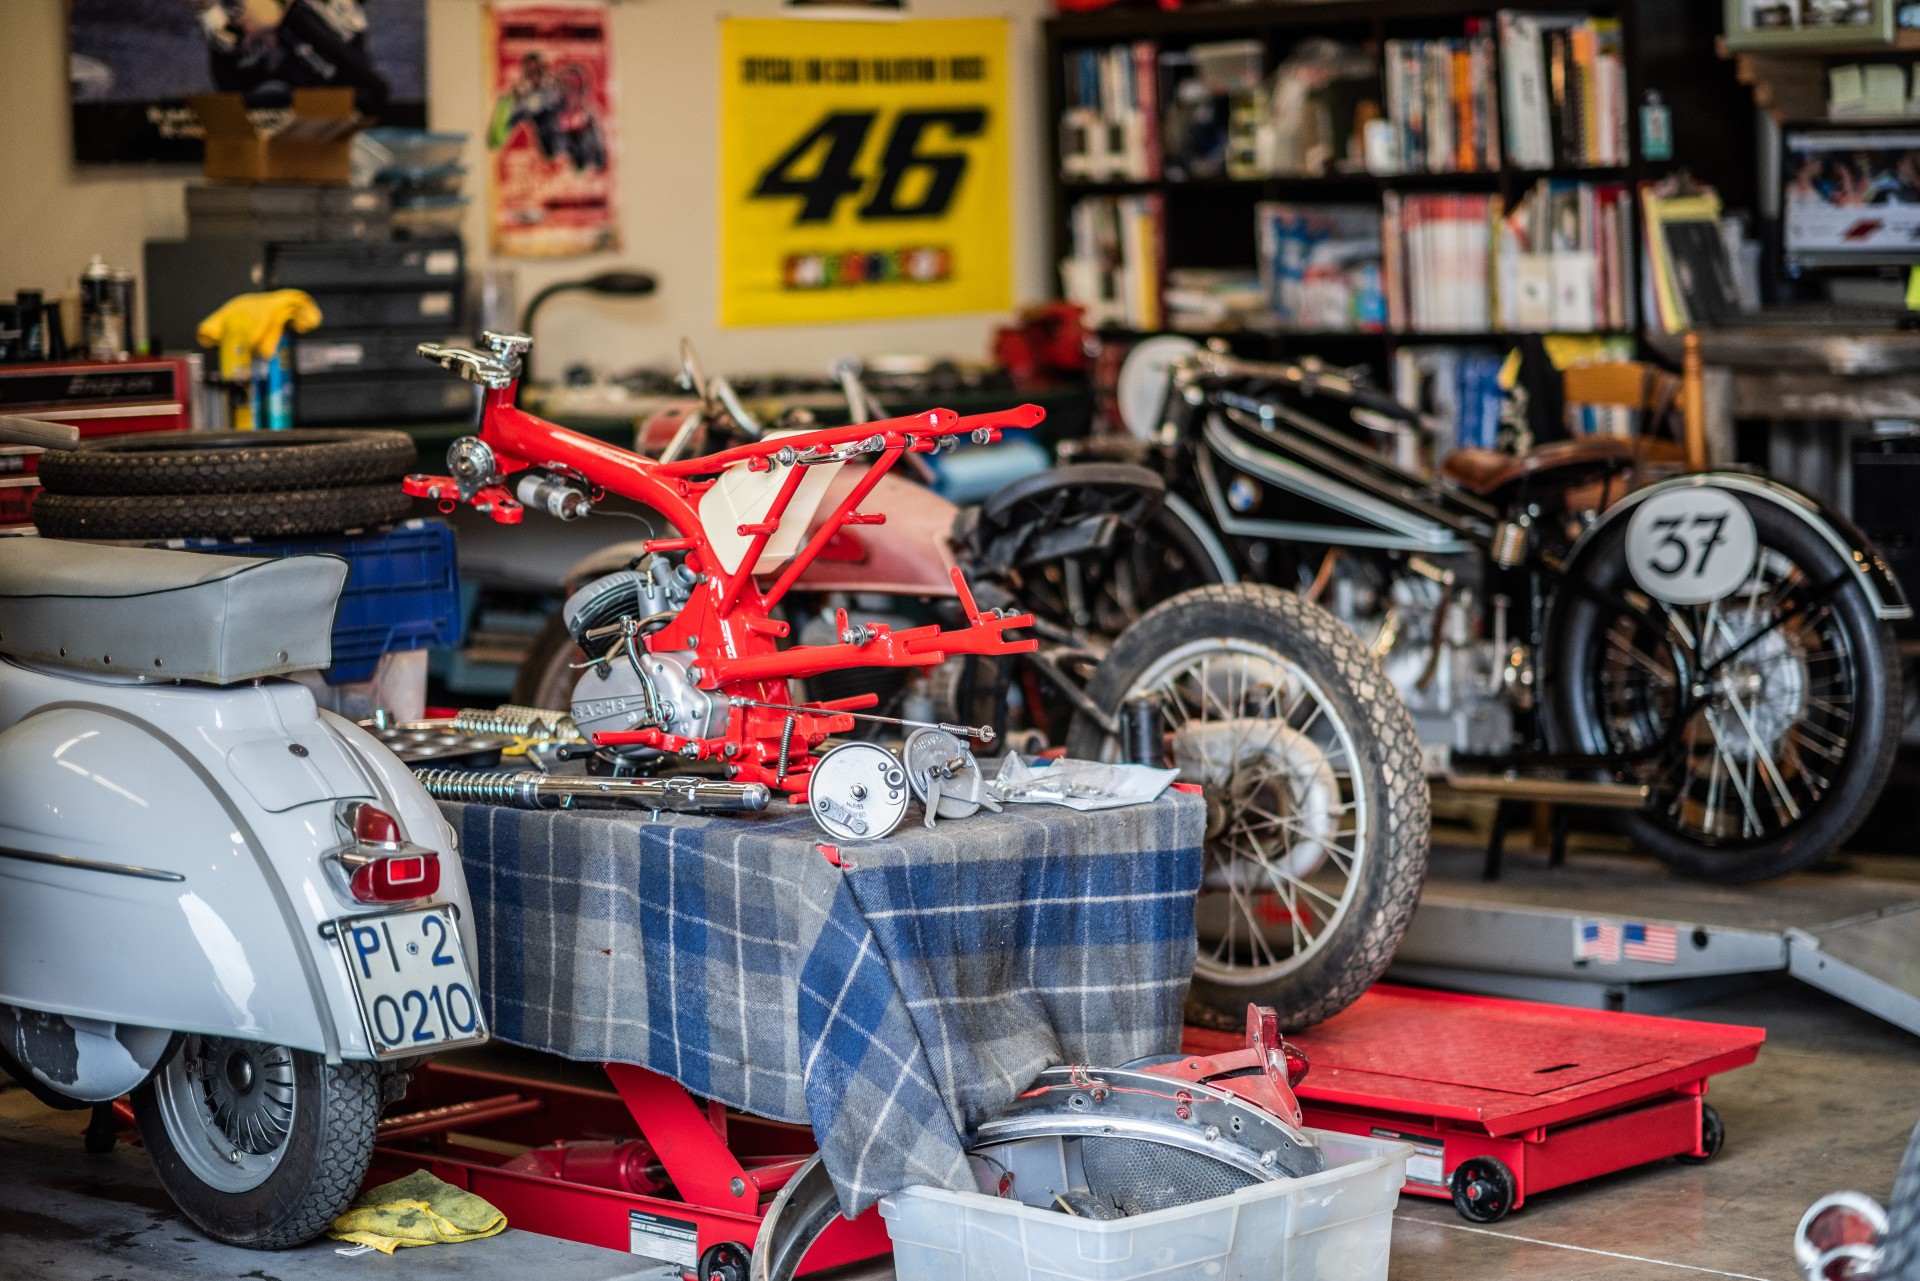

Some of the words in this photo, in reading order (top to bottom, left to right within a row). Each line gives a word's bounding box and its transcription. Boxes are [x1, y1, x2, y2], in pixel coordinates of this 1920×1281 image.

[749, 107, 989, 227] 46
[1649, 511, 1730, 578] 37
[576, 697, 627, 720] SACHS
[351, 921, 401, 979] PI
[421, 914, 455, 967] 2
[373, 982, 476, 1046] 0210
